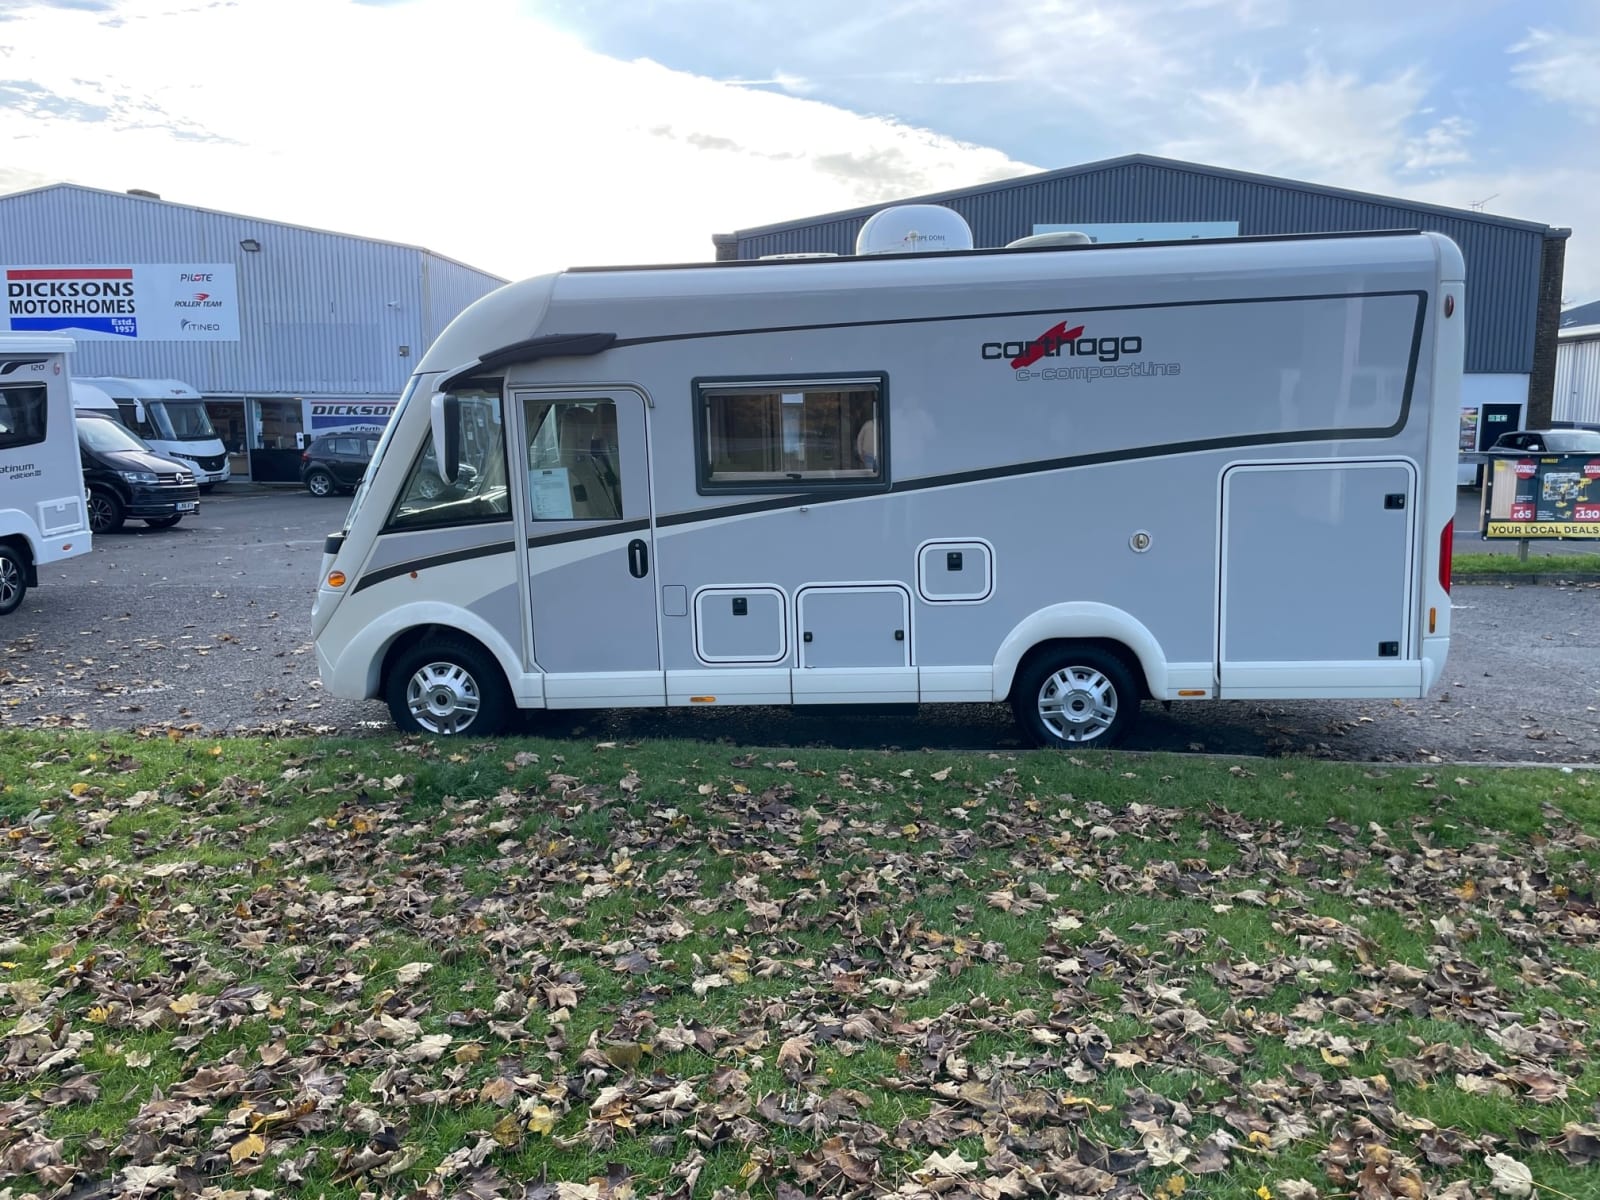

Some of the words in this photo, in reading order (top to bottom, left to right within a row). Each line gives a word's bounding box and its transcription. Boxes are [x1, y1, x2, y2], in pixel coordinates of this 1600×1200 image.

[8, 282, 134, 298] DICKSONS
[9, 299, 135, 315] MOTORHOMES
[981, 336, 1142, 362] carthago
[1015, 361, 1181, 383] c-compactline
[1514, 510, 1531, 518] £65
[1576, 510, 1600, 518] £130
